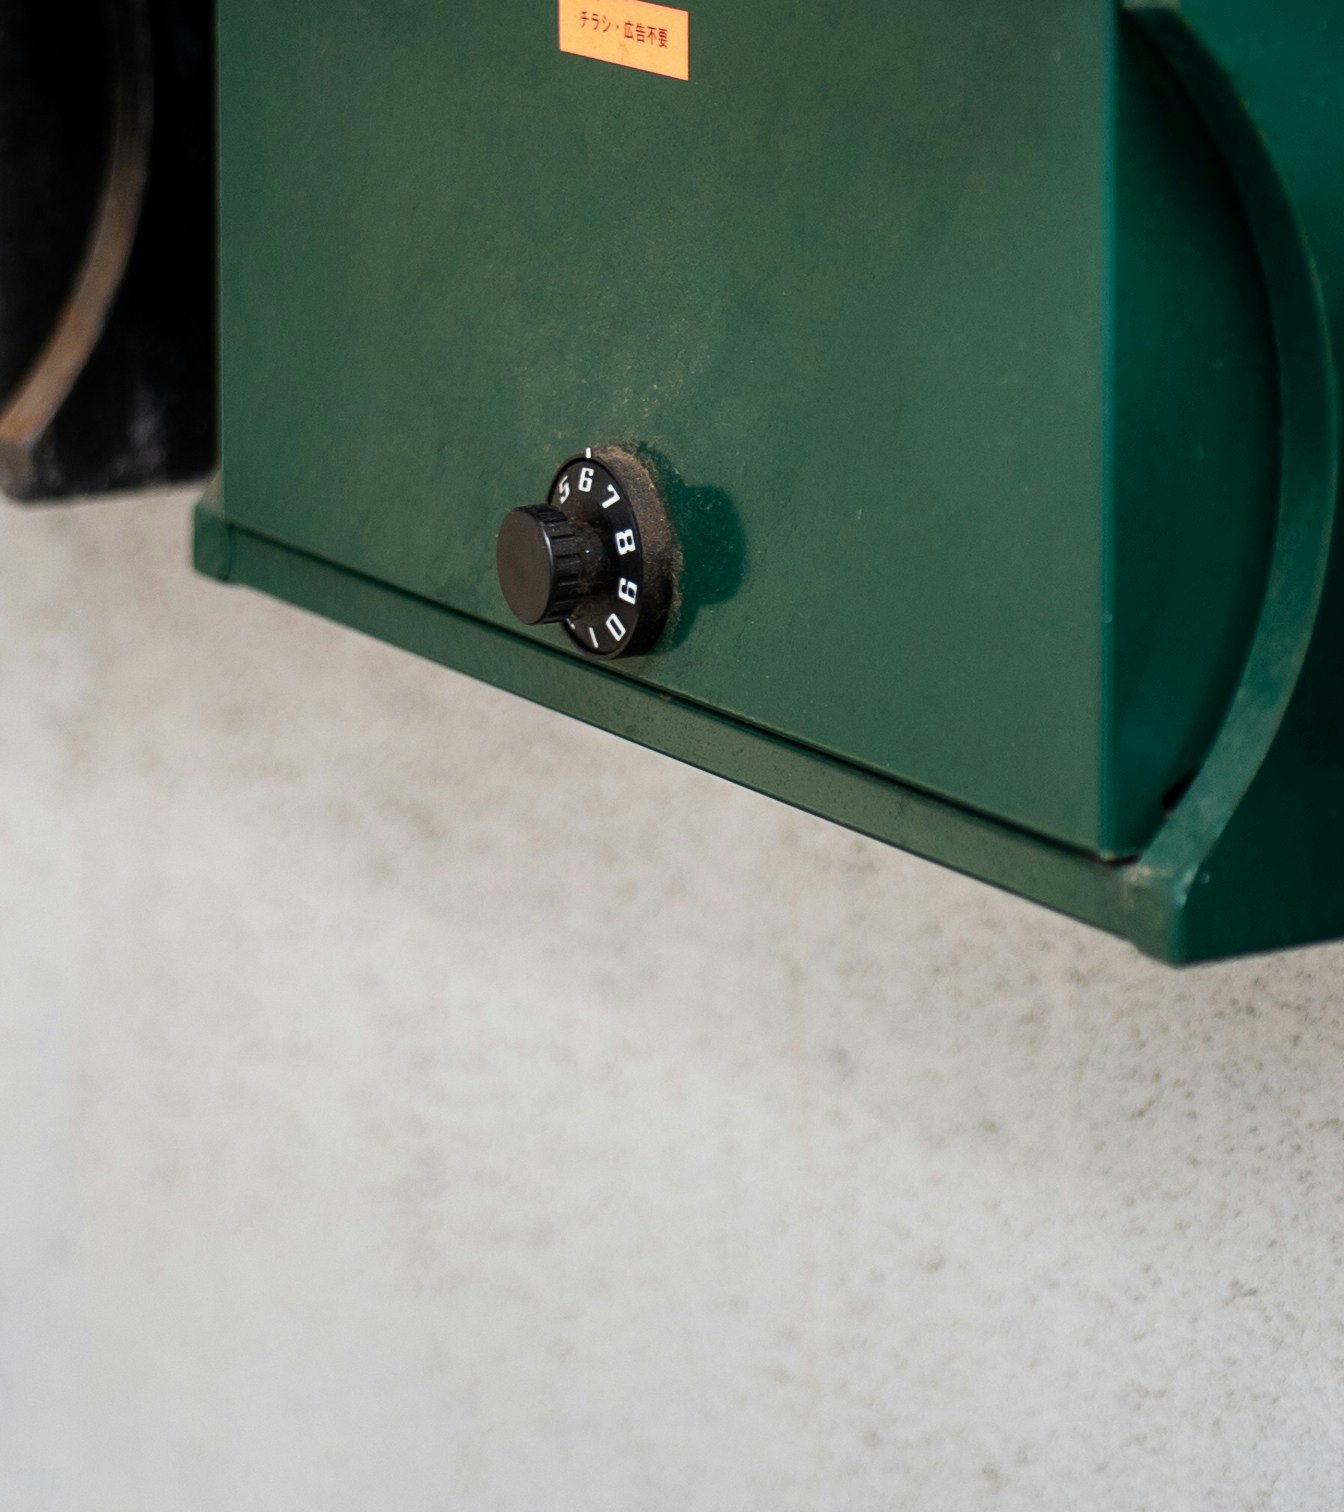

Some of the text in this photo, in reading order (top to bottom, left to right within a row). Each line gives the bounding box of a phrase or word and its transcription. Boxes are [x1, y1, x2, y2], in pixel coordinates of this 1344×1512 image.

[580, 11, 668, 48] チラシ・広告不要
[559, 467, 637, 648] 5 6 7 8 9 0 1
